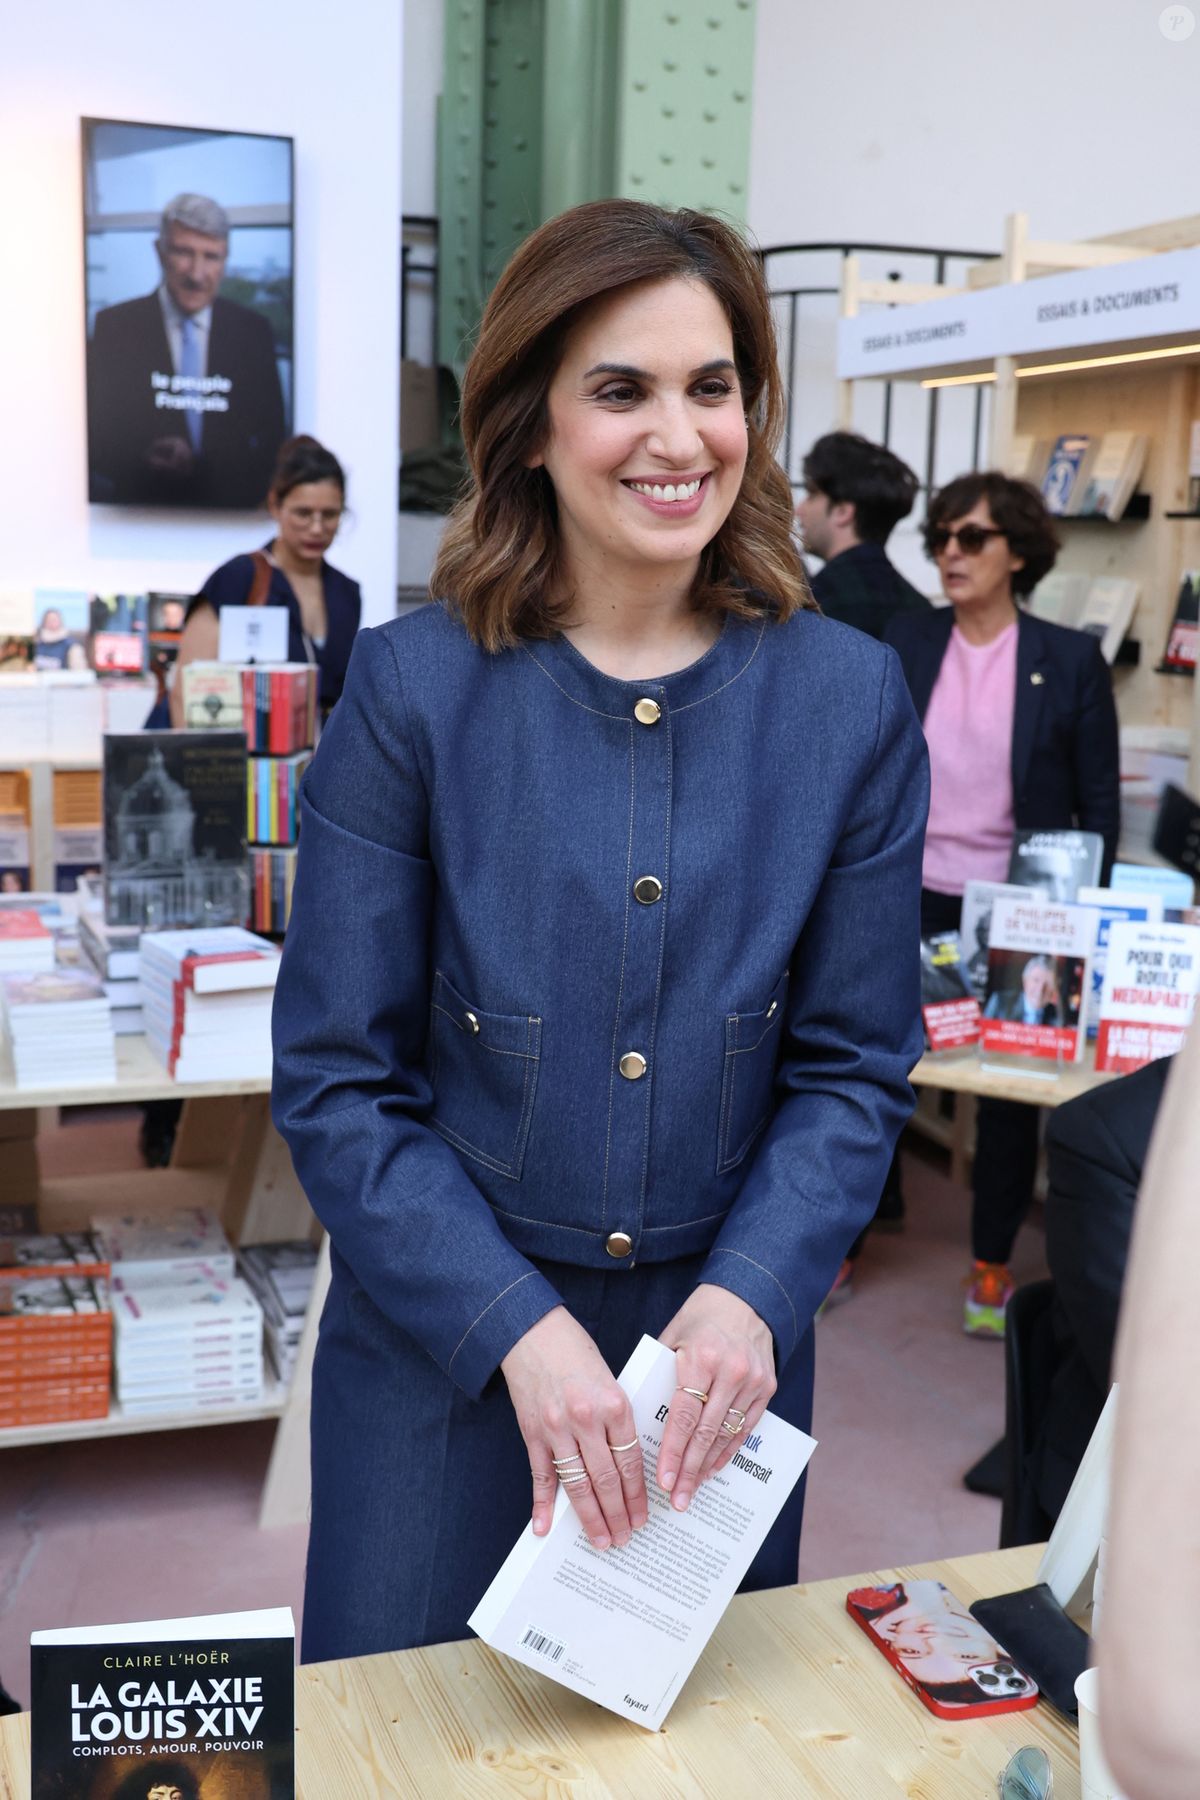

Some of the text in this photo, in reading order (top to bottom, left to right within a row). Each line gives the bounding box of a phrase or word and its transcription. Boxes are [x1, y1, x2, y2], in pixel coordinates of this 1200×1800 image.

[1037, 283, 1180, 322] ESSAIS & DOCUMENTS
[905, 321, 966, 346] DOCUMENTS
[170, 375, 232, 393] peuple
[155, 391, 229, 414] Français
[1015, 906, 1067, 921] PHILIPPE
[1025, 920, 1075, 935] VILLIERS
[1127, 950, 1164, 966] POUR
[655, 1404, 669, 1422] Et
[731, 1450, 773, 1484] inversait
[103, 1650, 230, 1669] CLAIRE L'HOËR
[71, 1677, 263, 1709] LA GALAXIE
[623, 1694, 649, 1713] fayard
[71, 1706, 264, 1742] LOUIS XIV
[72, 1740, 264, 1757] COMPLOTS, AMOUR, POUVOIR
